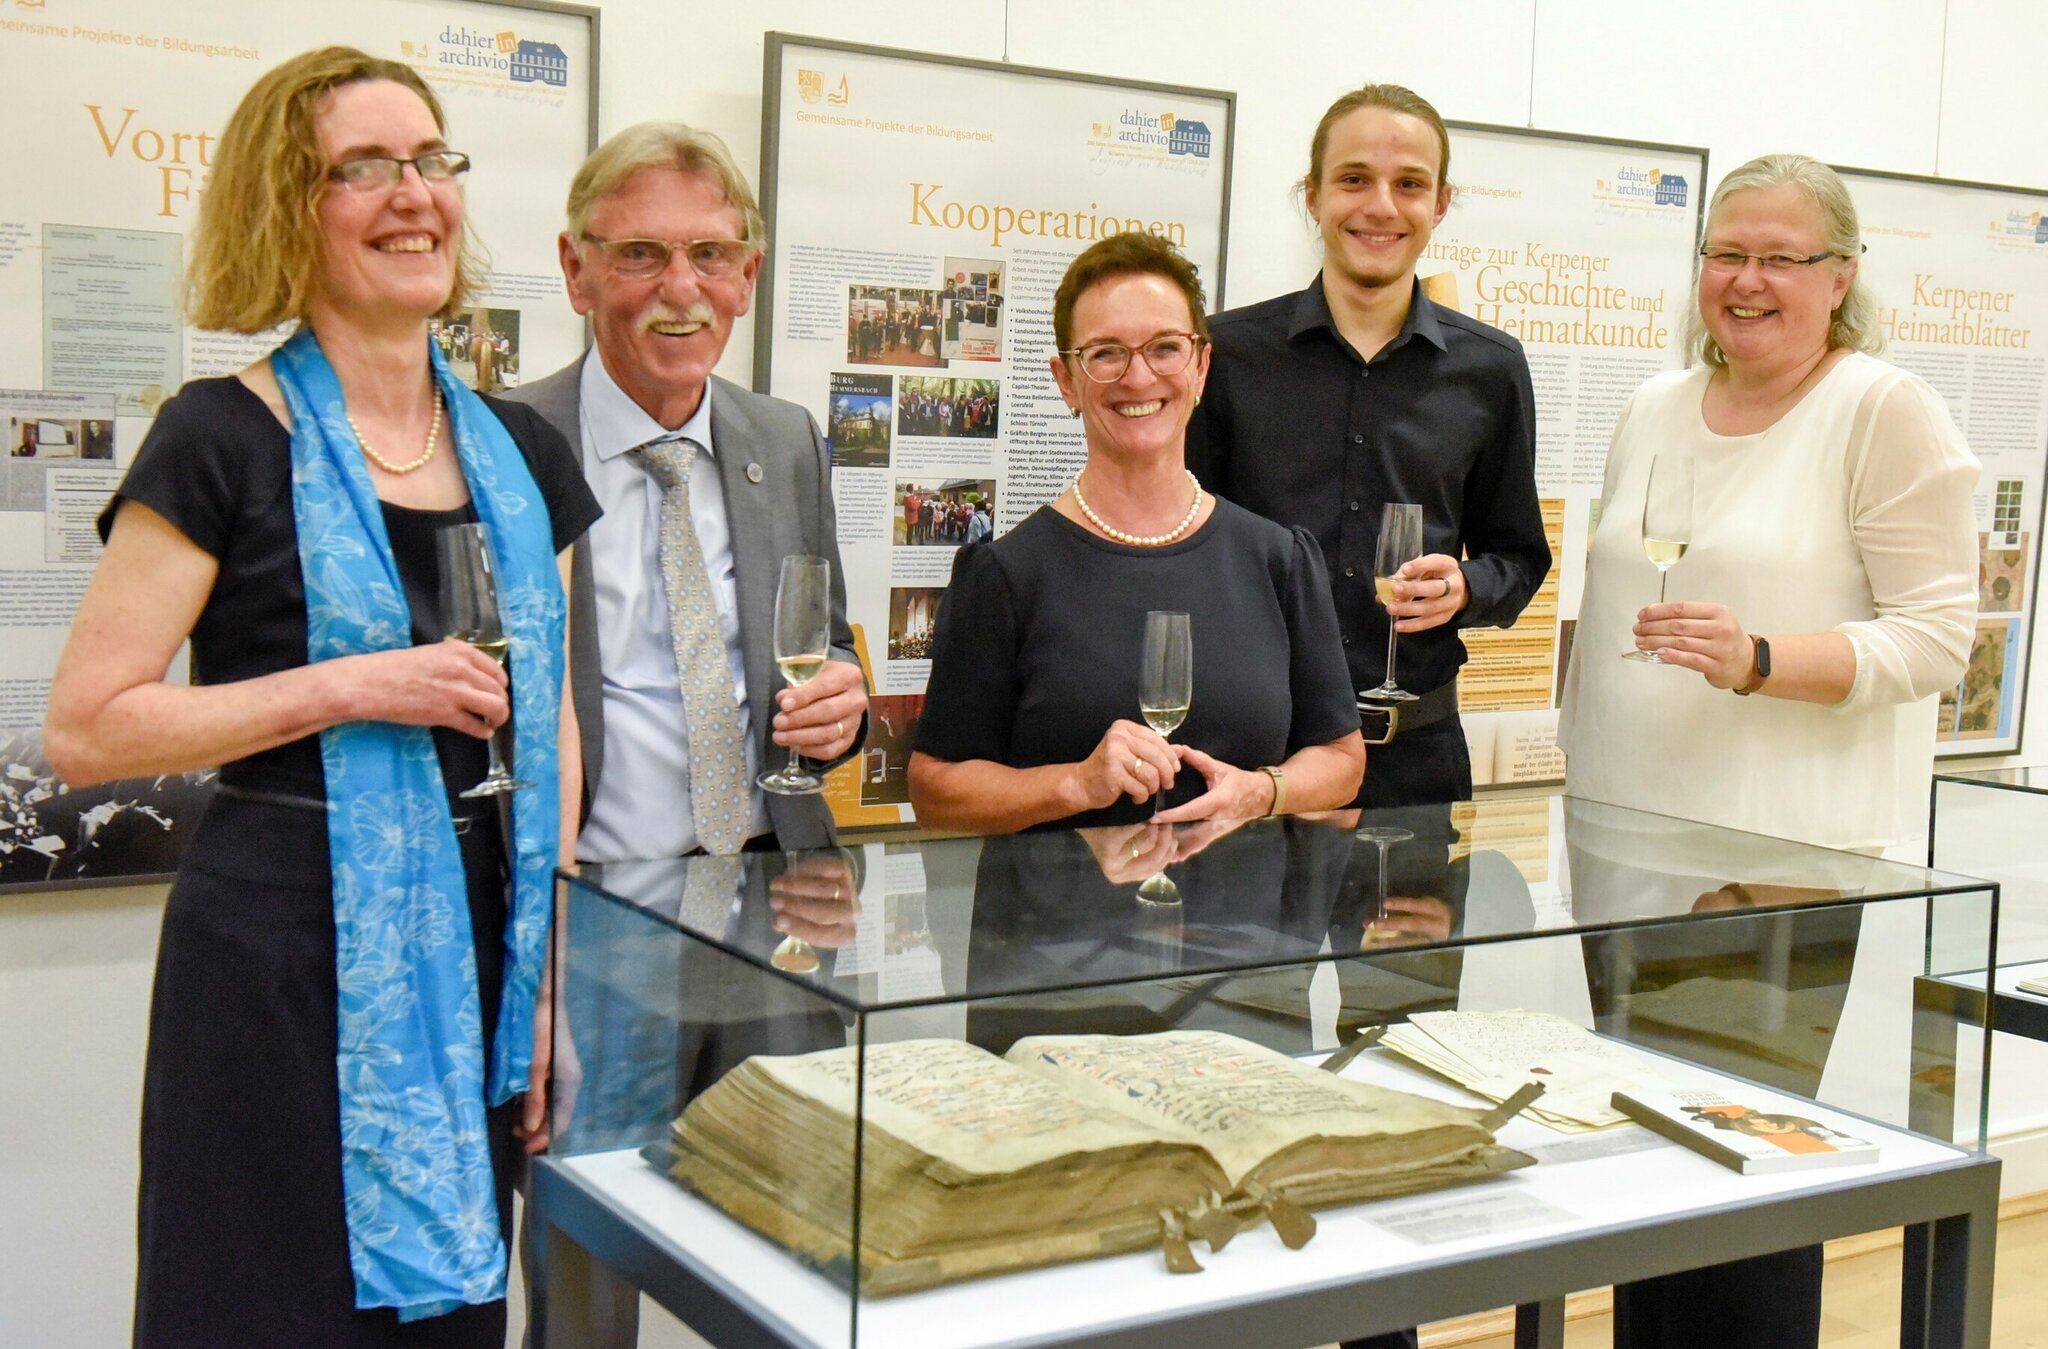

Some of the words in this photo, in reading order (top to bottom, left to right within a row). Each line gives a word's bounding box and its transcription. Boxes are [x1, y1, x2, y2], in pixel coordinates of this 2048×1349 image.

[72, 26, 132, 46] Projekte
[135, 34, 158, 48] der
[163, 37, 260, 60] Bildungsarbeit
[439, 25, 495, 50] dahier
[439, 48, 508, 71] archivio
[796, 110, 863, 128] Gemeinsame
[865, 117, 905, 133] Projekte
[908, 122, 924, 135] der
[926, 125, 993, 142] Bildungsarbeit
[1119, 108, 1160, 128] dahier
[1118, 127, 1168, 145] archivio
[1617, 166, 1648, 182] dahier
[1472, 185, 1522, 199] Bildungsarbeit
[1616, 182, 1655, 197] archivio
[908, 182, 1187, 248] Kooperationen
[1418, 238, 1481, 270] iträge
[1487, 248, 1518, 267] zur
[1524, 242, 1610, 278] Kerpener
[1475, 265, 1626, 310] Geschichte
[1630, 288, 1665, 314] und
[1911, 273, 2014, 320] Kerpener
[1014, 318, 1046, 326] Katholisches
[1474, 303, 1668, 350] Heimatkunde
[1878, 306, 2031, 349] Heimatblätter
[1013, 338, 1052, 346] Kolpingsfamilie
[830, 374, 854, 384] BURG
[1040, 412, 1072, 420] Hoensbroech
[1029, 430, 1047, 438] Berghe
[1008, 448, 1039, 456] Abteilungen
